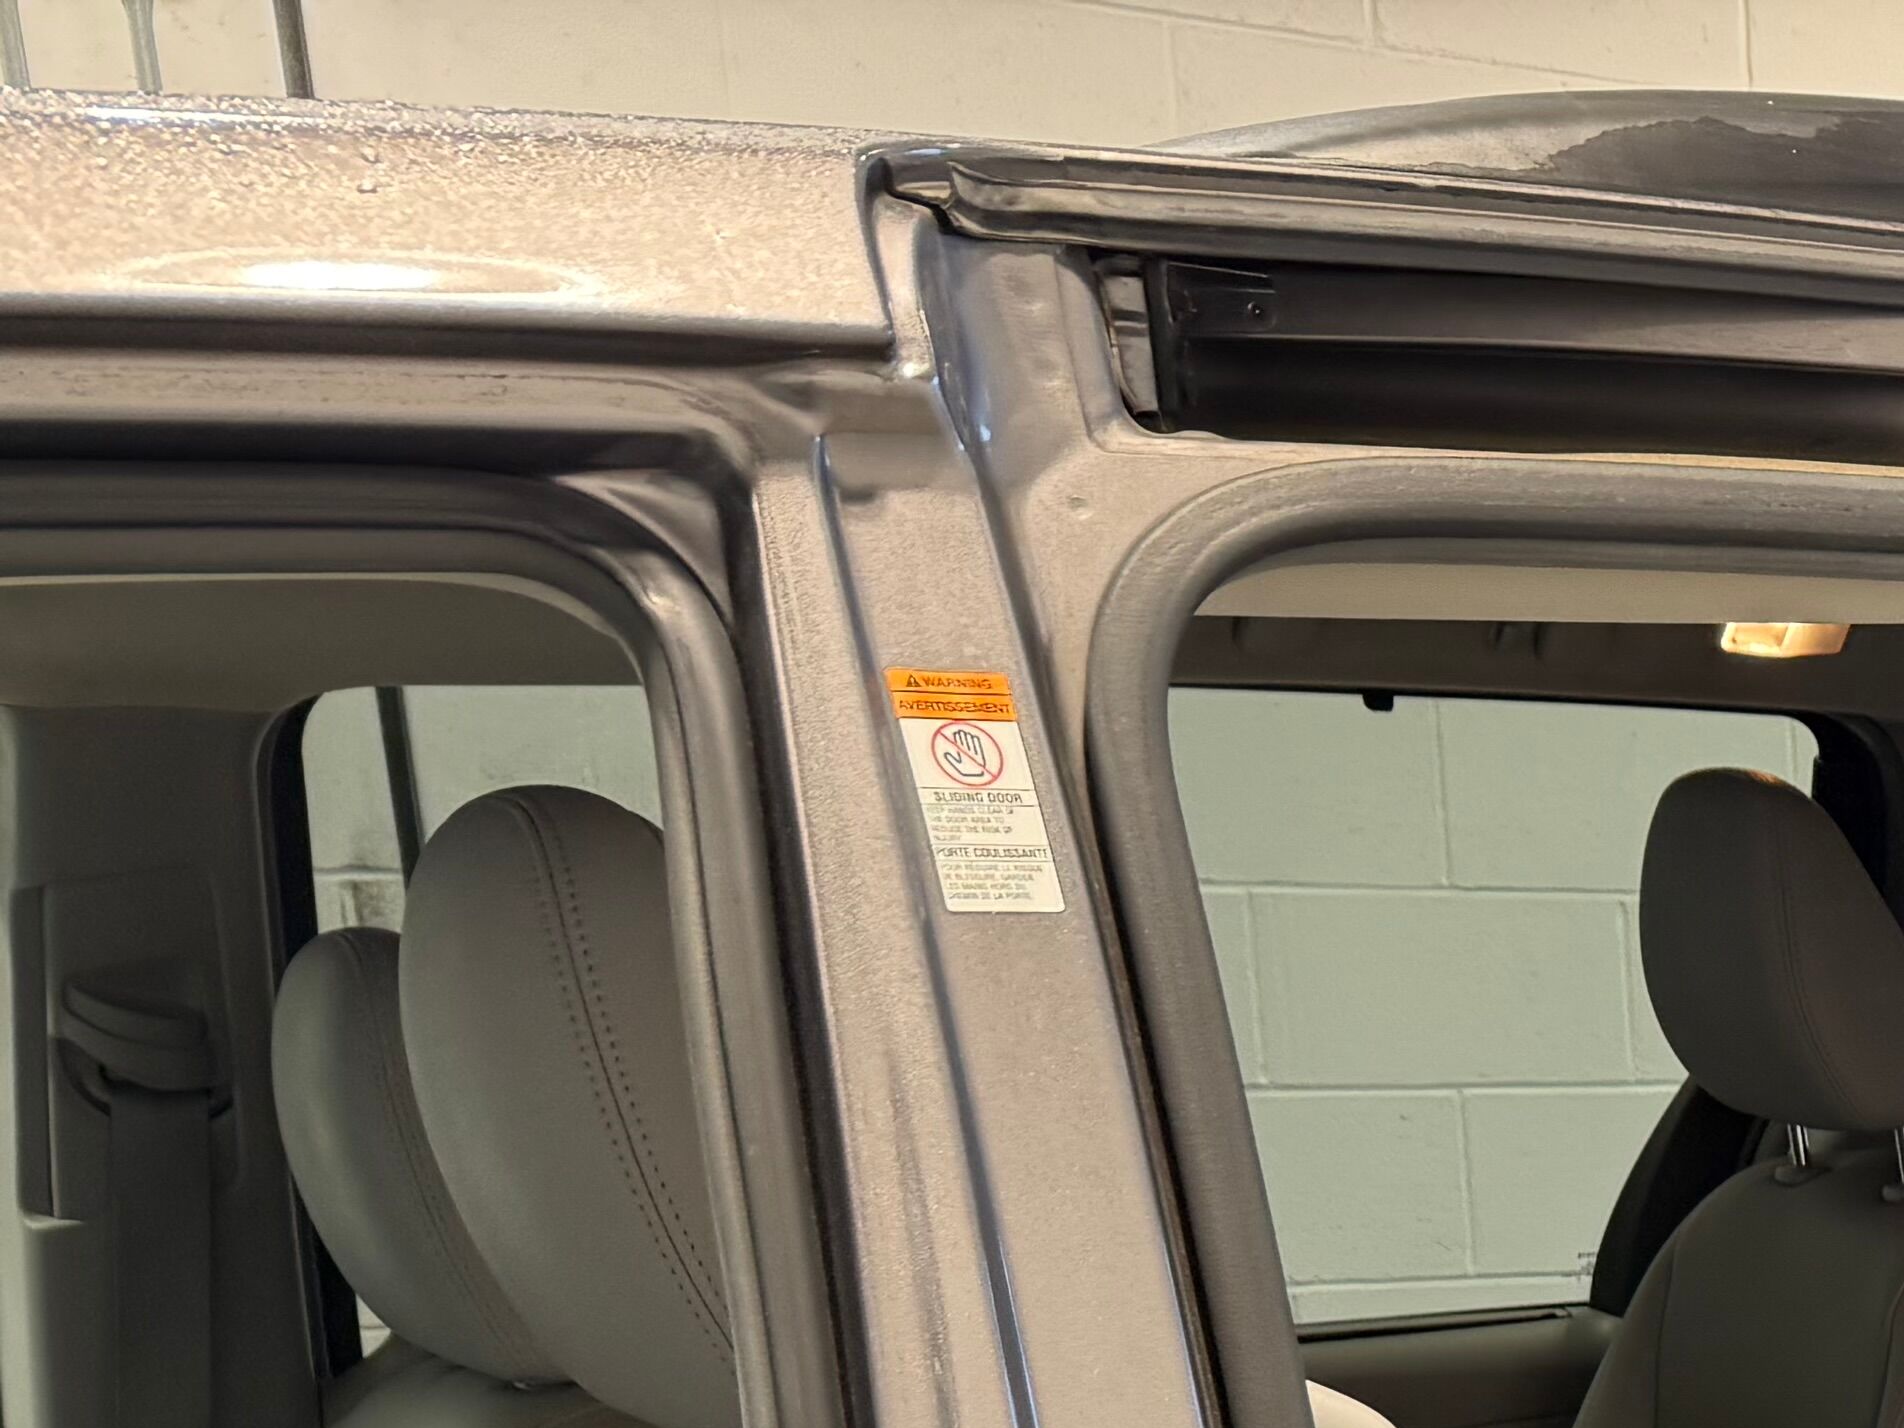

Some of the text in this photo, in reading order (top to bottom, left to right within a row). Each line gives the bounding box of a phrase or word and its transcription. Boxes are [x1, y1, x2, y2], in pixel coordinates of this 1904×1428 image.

[921, 675, 992, 689] WARNING
[932, 791, 1023, 803] SLIDING DOOR
